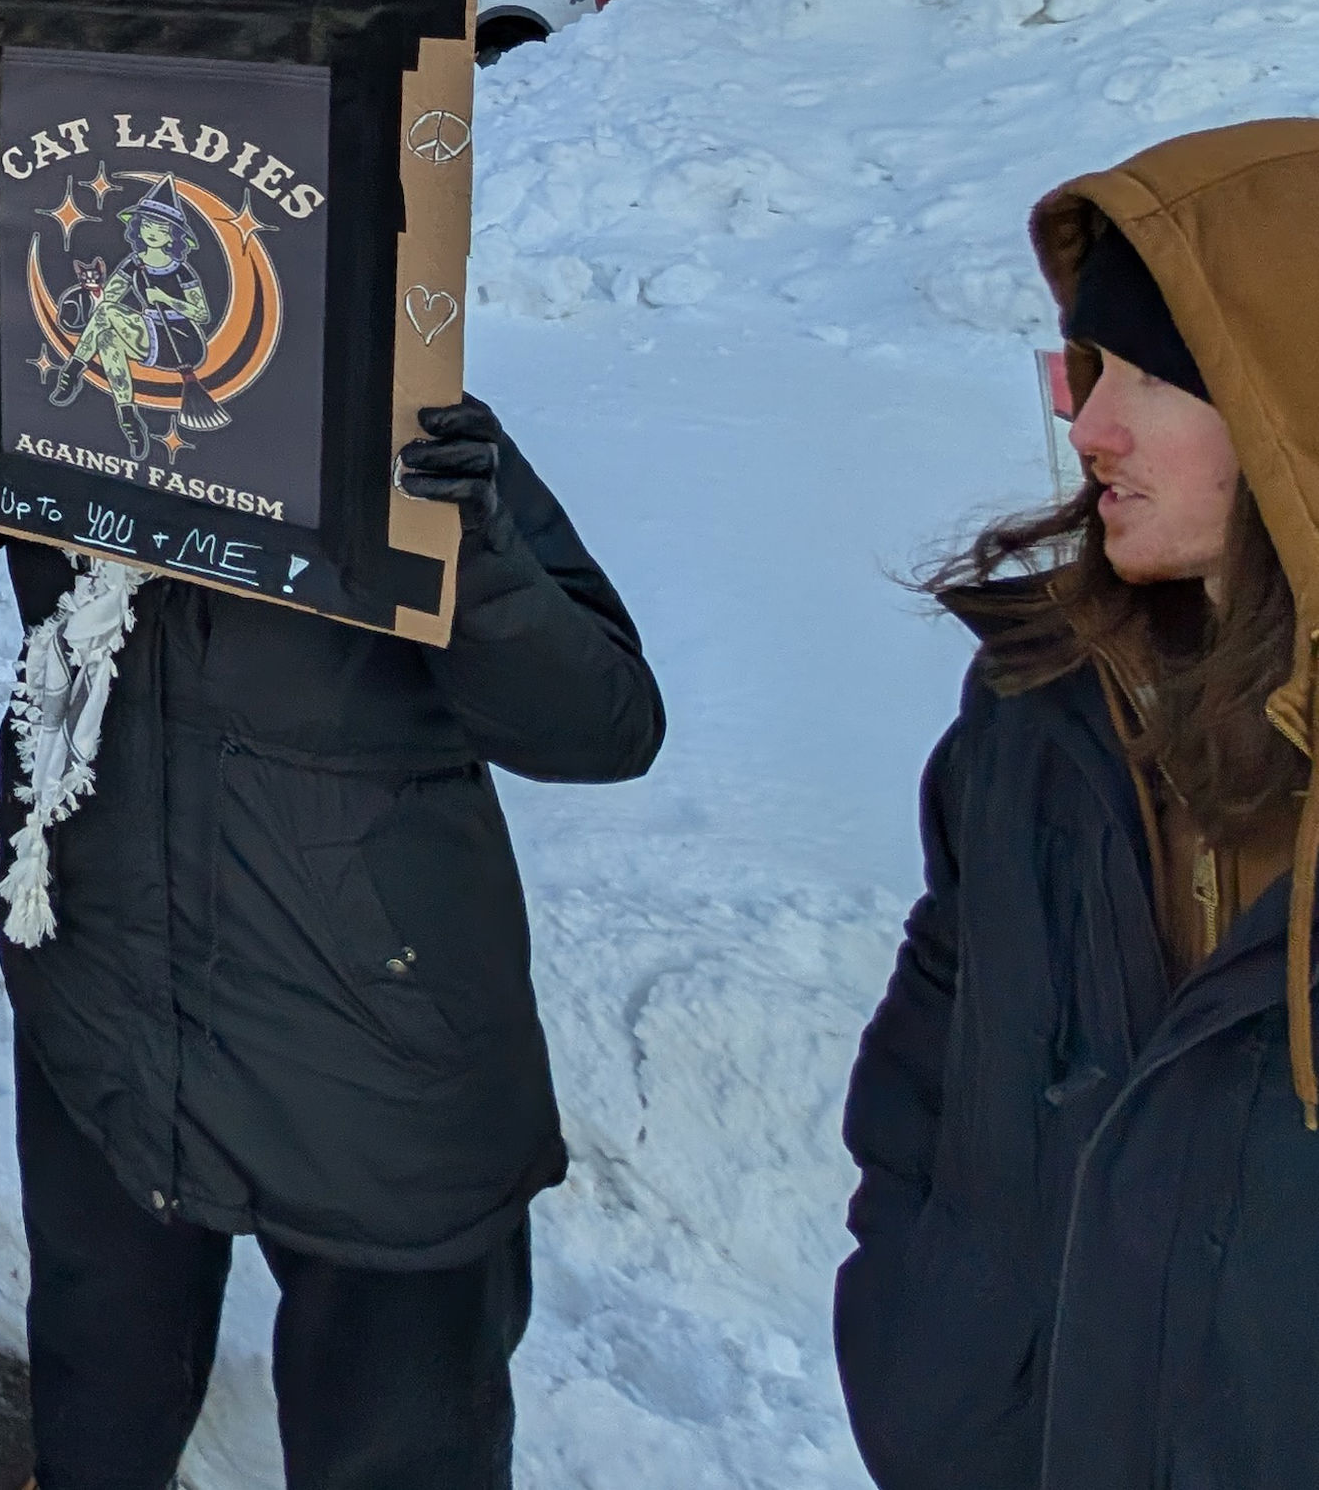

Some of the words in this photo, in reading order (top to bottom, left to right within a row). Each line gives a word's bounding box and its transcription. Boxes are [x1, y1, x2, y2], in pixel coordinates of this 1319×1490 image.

[2, 118, 90, 180] CAT
[114, 114, 325, 218] LADIES
[15, 433, 139, 480] AGAINST
[148, 466, 284, 521] FASCISM
[87, 502, 135, 543] YOU
